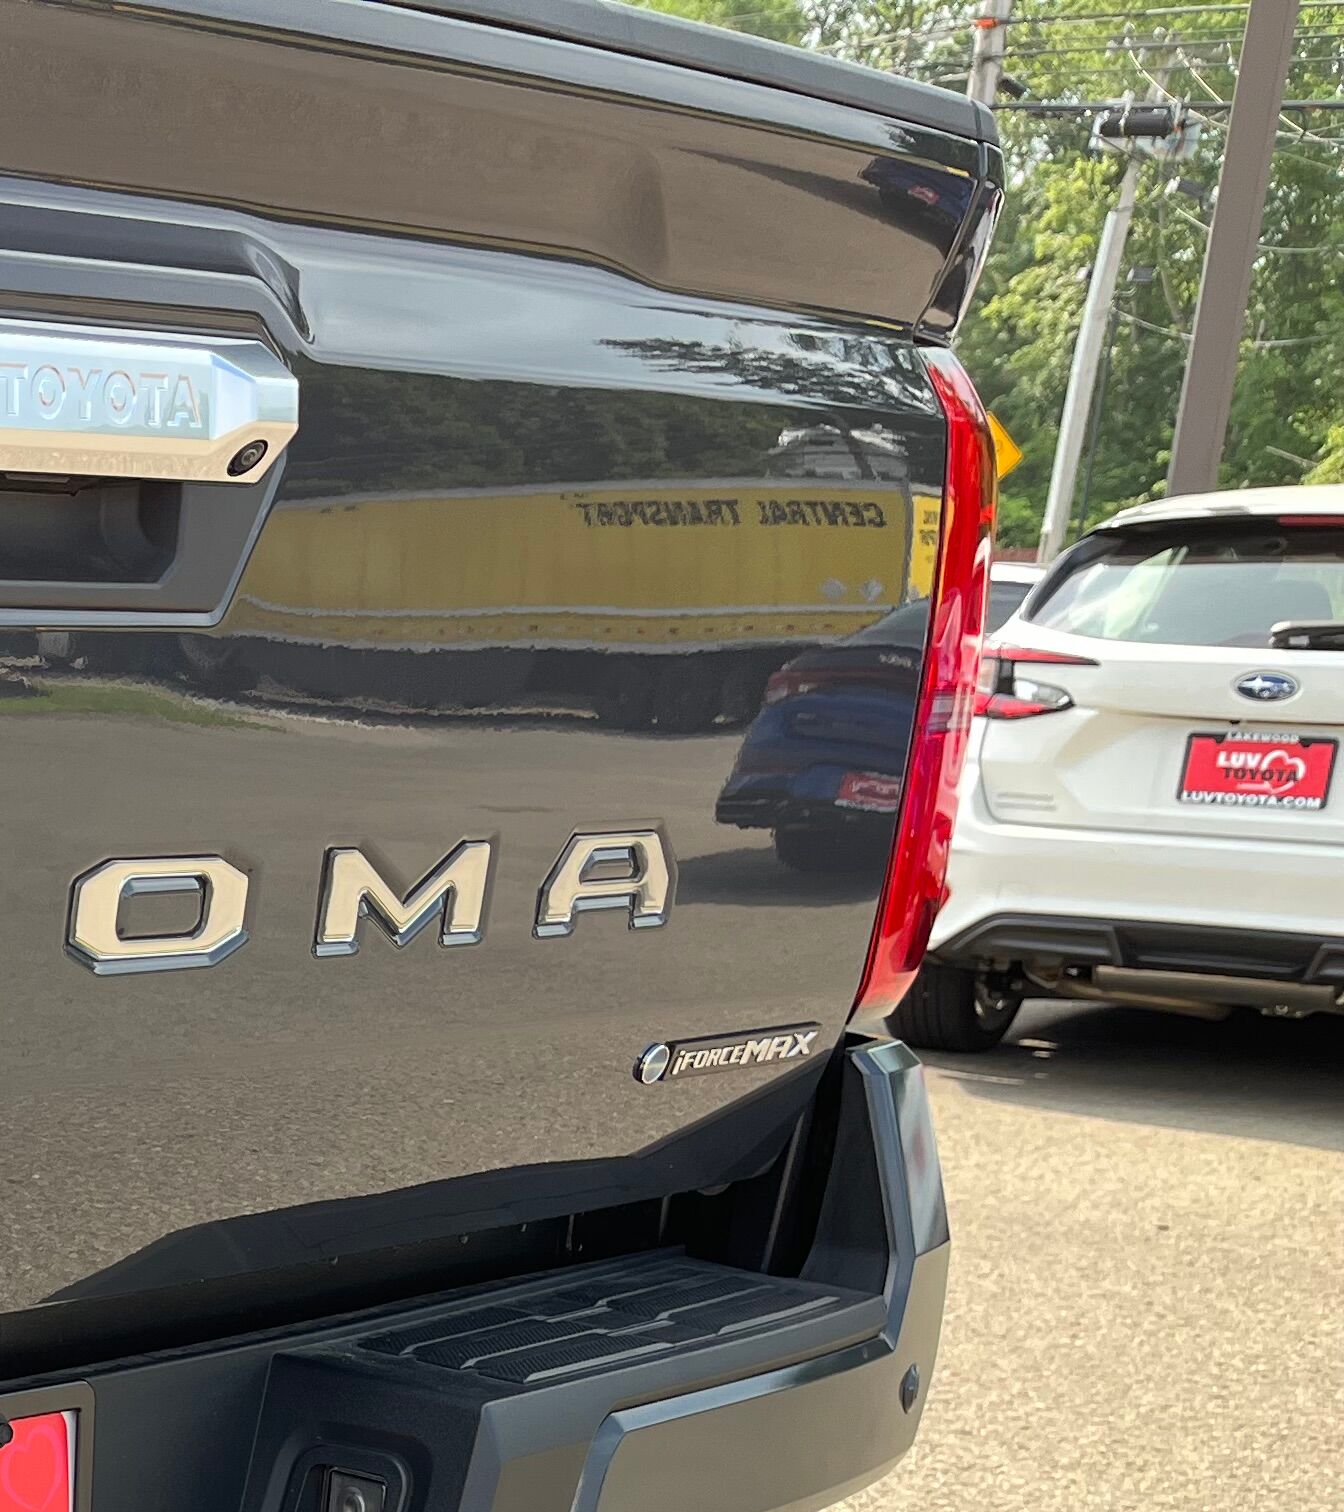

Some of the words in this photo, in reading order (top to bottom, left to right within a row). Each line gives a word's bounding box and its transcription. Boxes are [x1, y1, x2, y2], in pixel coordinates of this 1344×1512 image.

[1216, 751, 1262, 768] LUV
[1223, 767, 1300, 783] TOYOTA
[1182, 789, 1322, 810] LUVTOYOTA.COM
